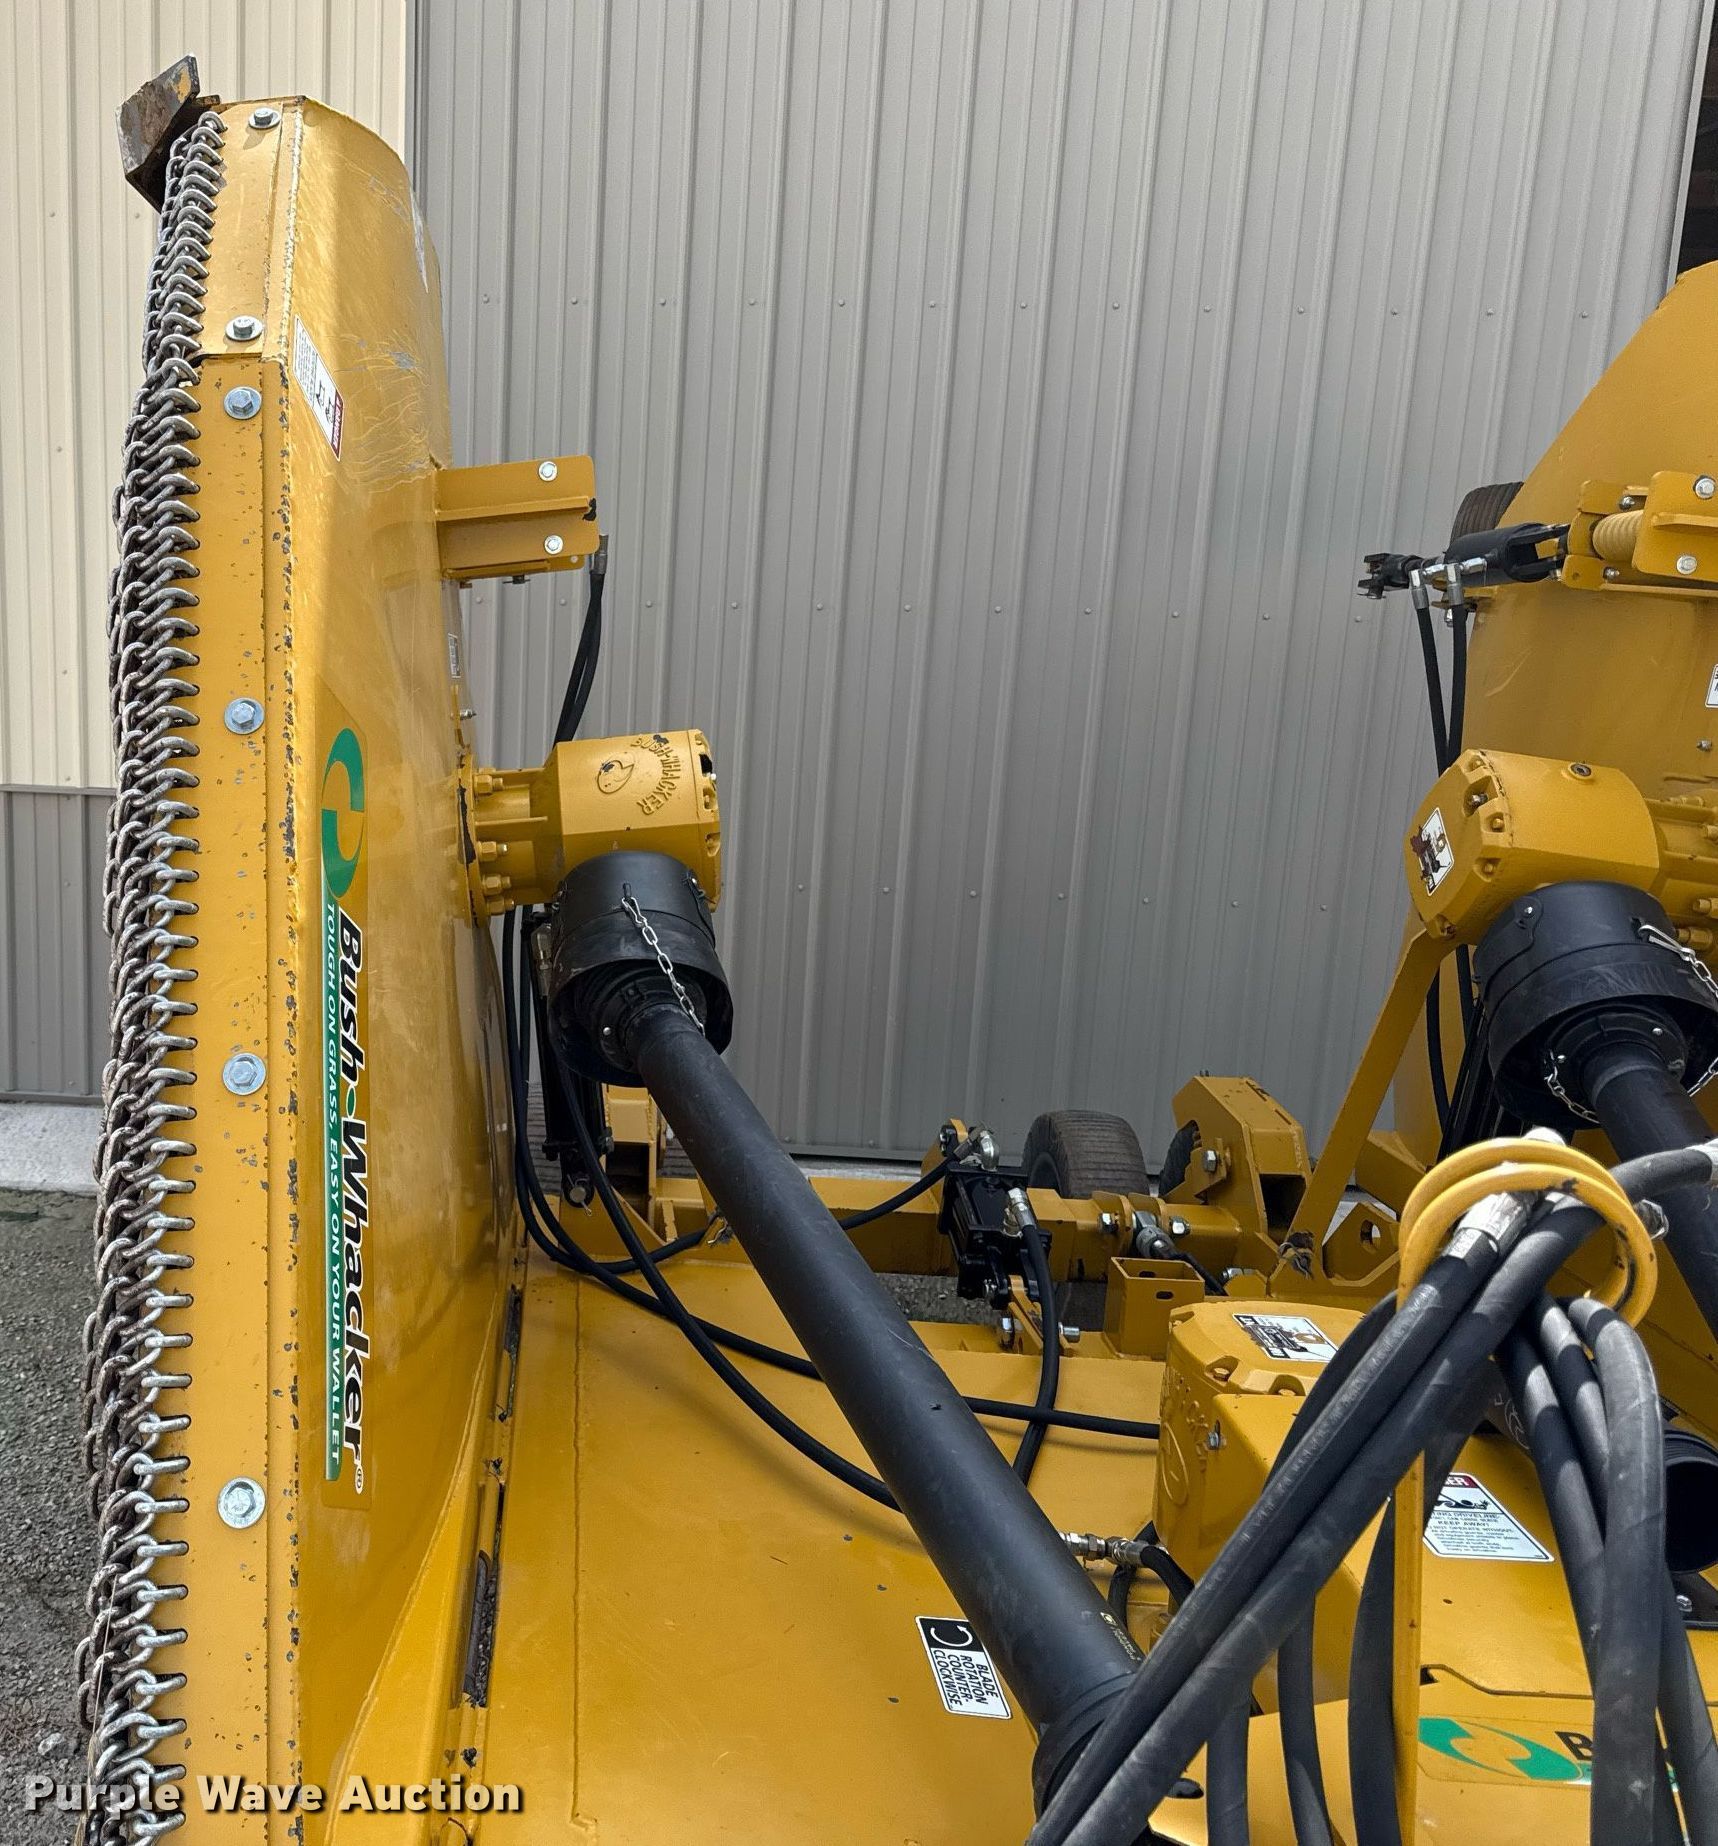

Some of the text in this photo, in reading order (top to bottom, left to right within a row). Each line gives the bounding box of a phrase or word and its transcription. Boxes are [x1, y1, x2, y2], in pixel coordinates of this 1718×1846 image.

[327, 904, 340, 1465] TOUGH ON GRASS, EASY ON YOUR WALLET
[933, 1650, 962, 1706] CLOCKWISE
[947, 1655, 973, 1702] COUNTER-
[960, 1655, 988, 1704] ROTATION
[976, 1664, 999, 1698] BLADE
